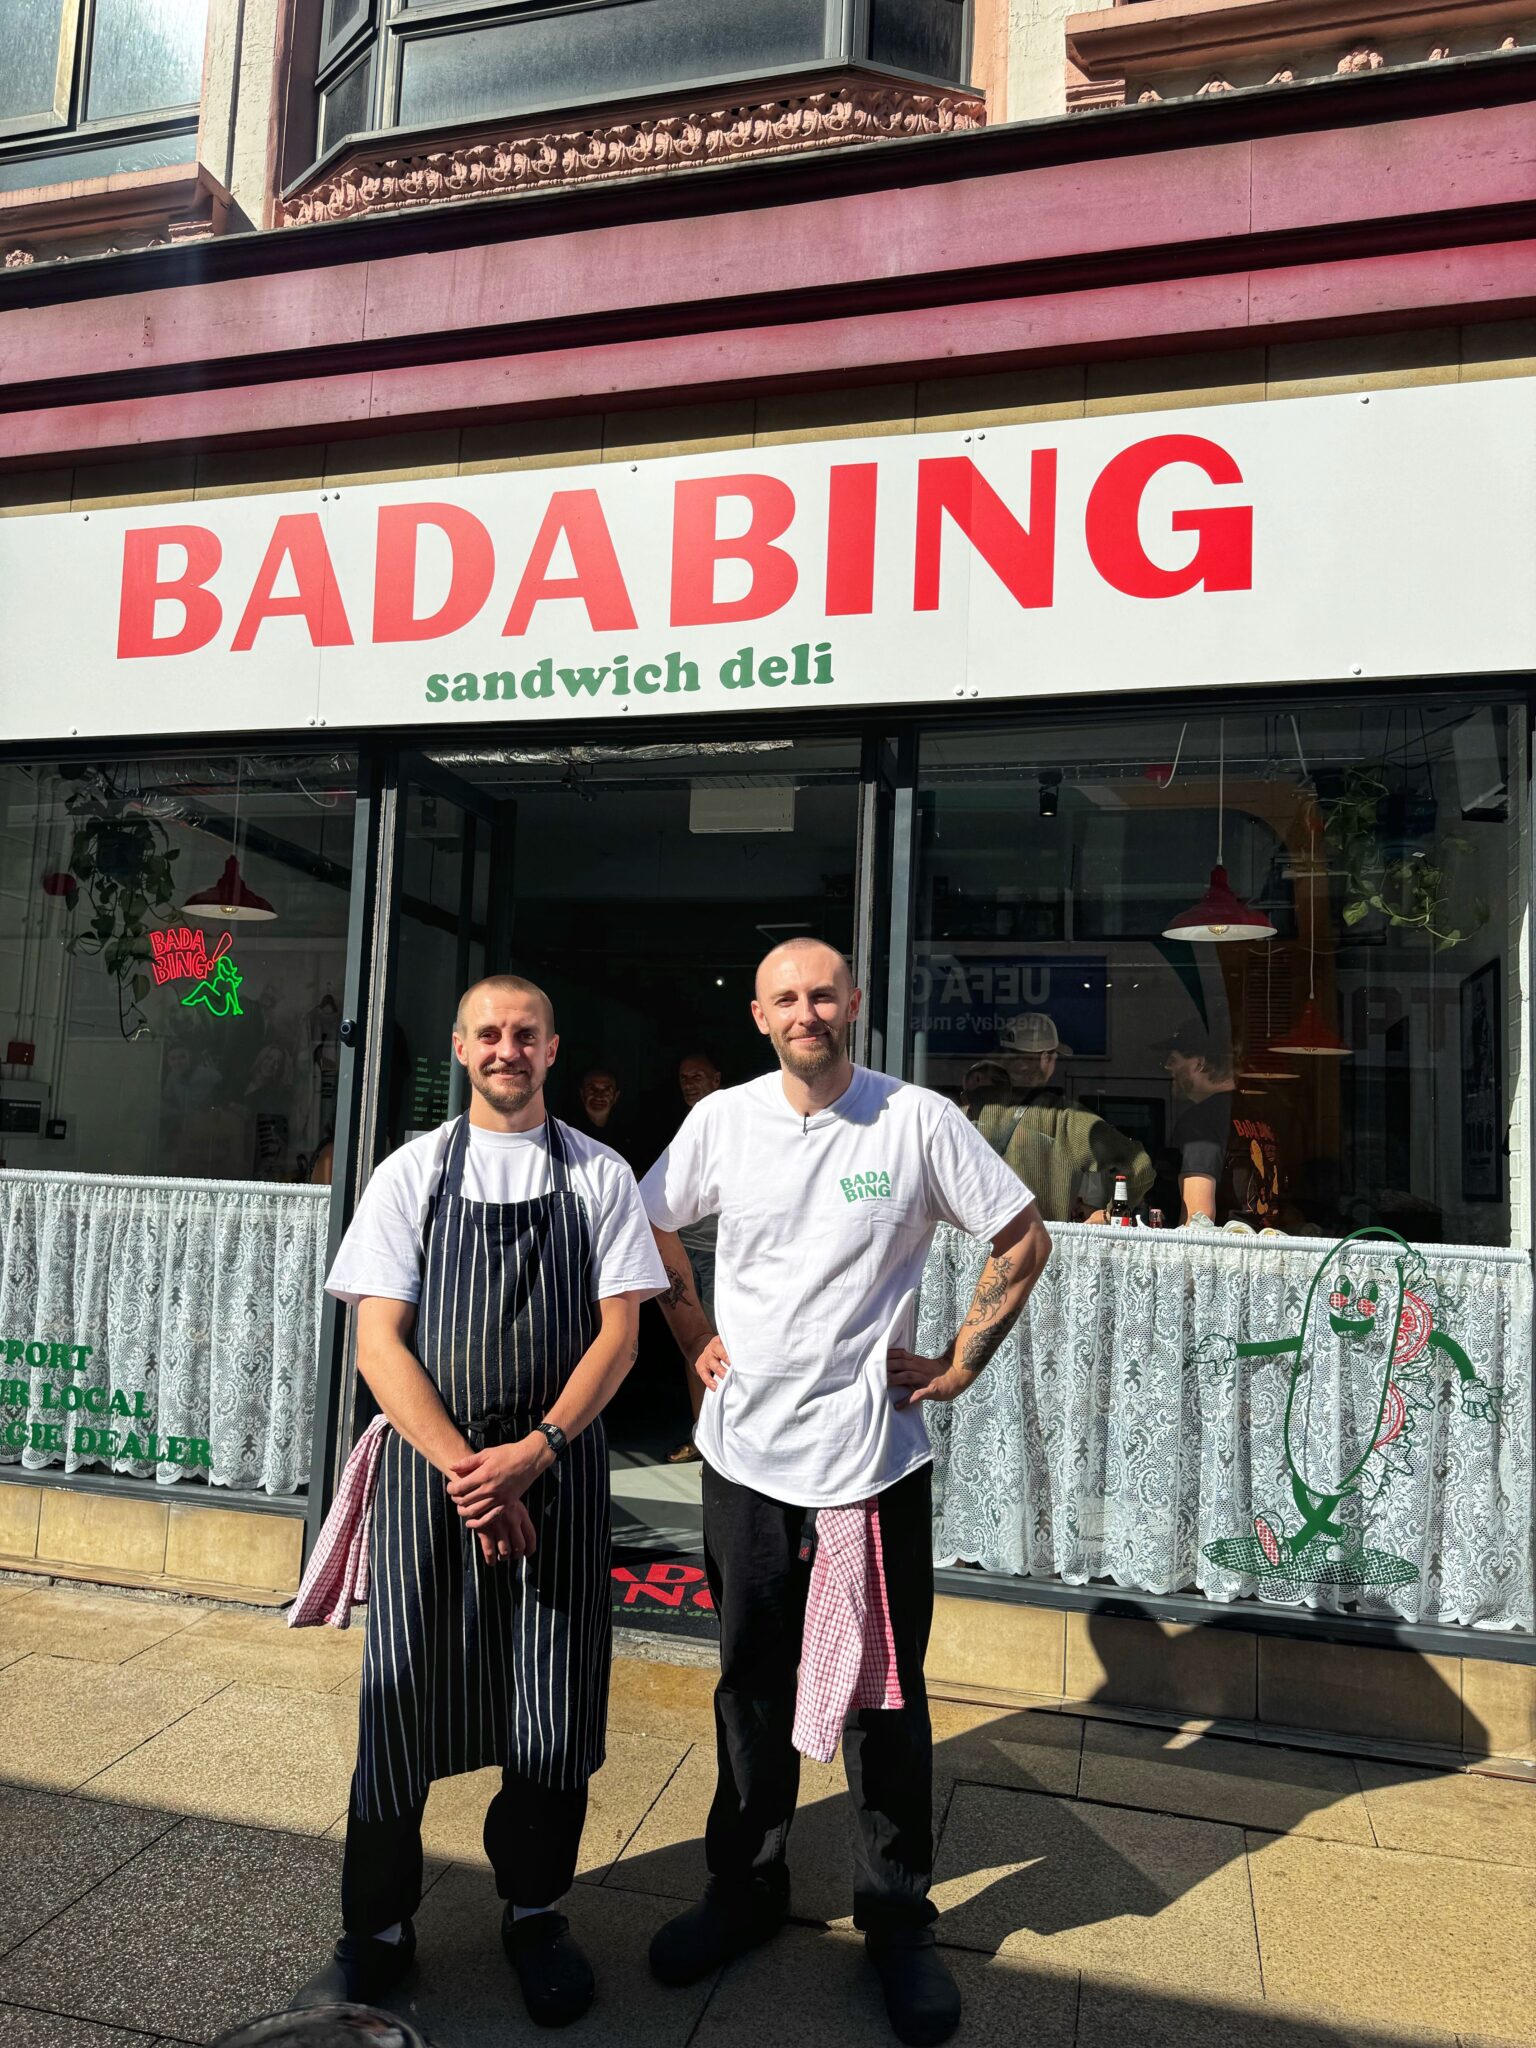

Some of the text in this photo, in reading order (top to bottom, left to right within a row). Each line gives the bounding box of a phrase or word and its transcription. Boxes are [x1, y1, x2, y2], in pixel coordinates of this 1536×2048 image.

[425, 642, 833, 704] sandwich deli
[149, 927, 206, 957] BADA
[839, 1170, 891, 1192] BADA
[844, 1183, 891, 1203] BING
[0, 1338, 93, 1372] PORT
[41, 1382, 152, 1418] LOCAL
[72, 1426, 213, 1469] DEALER
